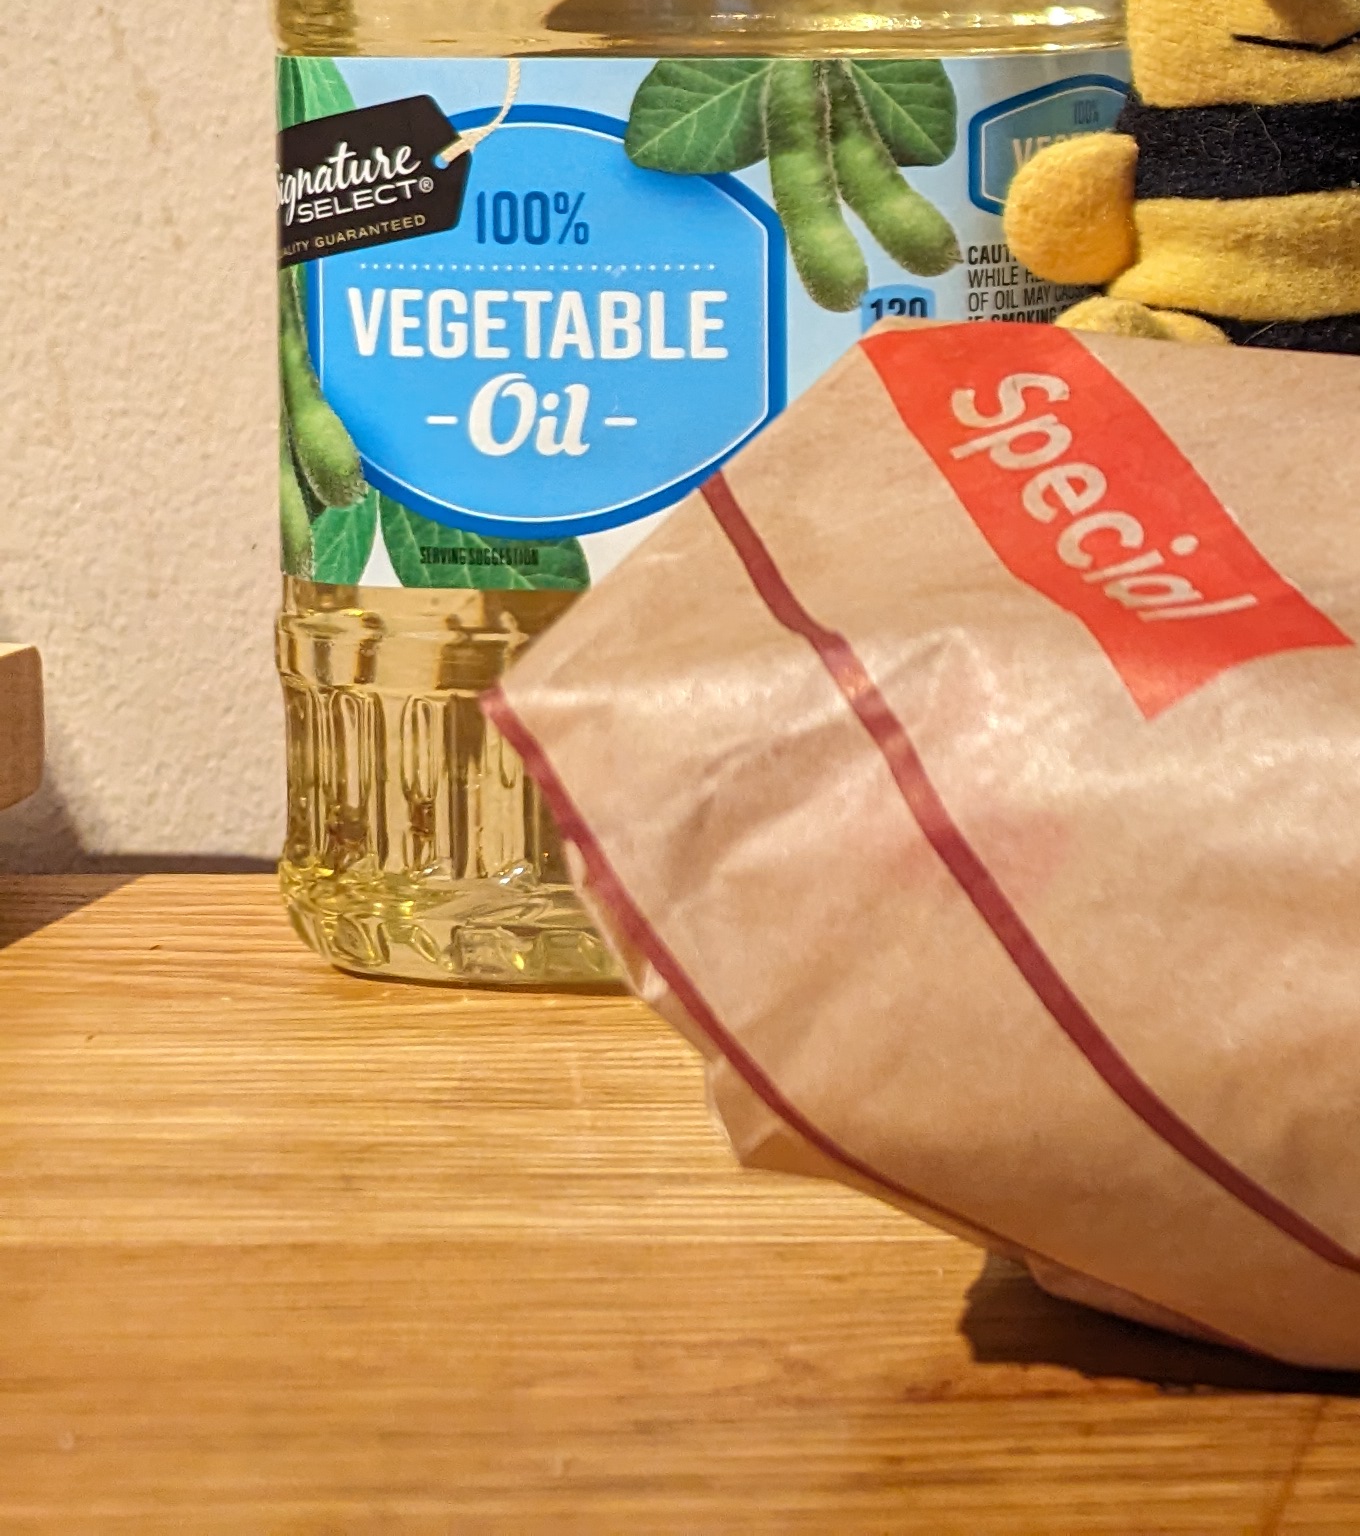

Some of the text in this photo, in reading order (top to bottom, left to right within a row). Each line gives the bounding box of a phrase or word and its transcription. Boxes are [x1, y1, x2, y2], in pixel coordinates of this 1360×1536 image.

[314, 214, 426, 248] GUARANTEED
[476, 191, 589, 245] 100%
[968, 266, 1019, 288] WHILE
[968, 292, 989, 312] OF
[995, 290, 1018, 310] OIL
[1024, 285, 1051, 306] MAY
[347, 288, 729, 360] VEGETABLE
[468, 372, 591, 457] Oil
[950, 372, 1259, 622] Special
[419, 546, 540, 566] SERVING SUGGESTION
